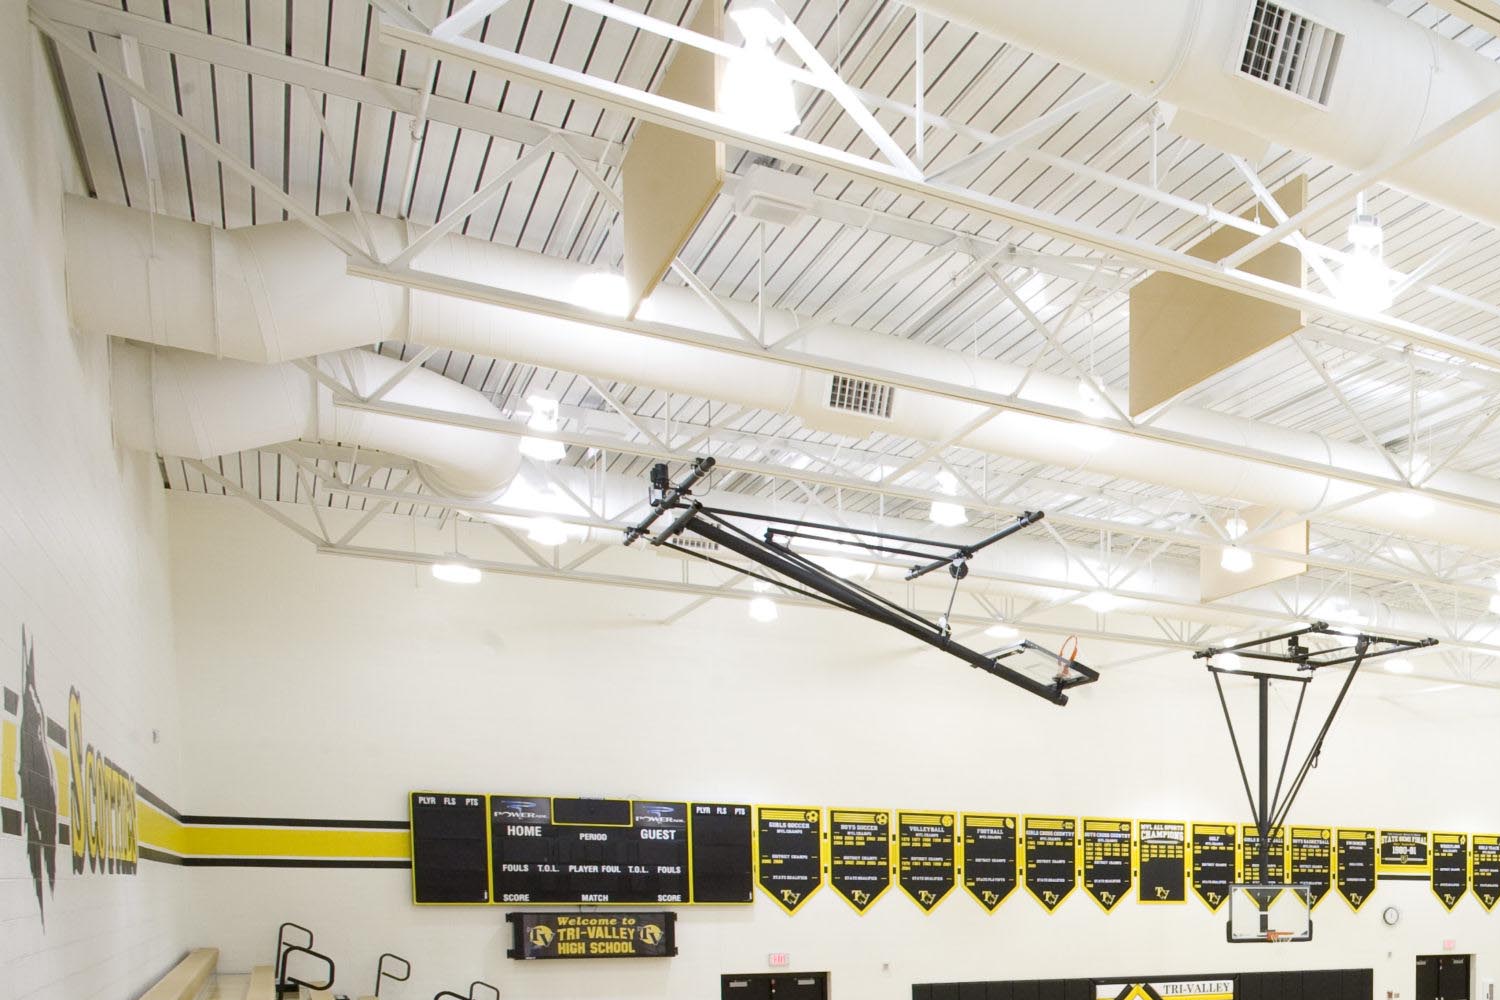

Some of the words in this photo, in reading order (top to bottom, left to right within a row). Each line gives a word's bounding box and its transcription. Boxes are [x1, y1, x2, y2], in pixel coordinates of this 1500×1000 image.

[418, 797, 436, 805] PLYR
[443, 797, 457, 805] FLS
[465, 798, 479, 806] PTS
[696, 806, 711, 814] PLYR
[716, 807, 728, 815] FLS
[507, 825, 542, 837] HOME
[640, 828, 676, 840] GUEST
[579, 832, 608, 841] PERIOD
[502, 864, 529, 872] FOULS
[537, 864, 560, 872] T.O.L.
[568, 865, 598, 873] PLAYER
[601, 865, 622, 873] FOUL
[627, 866, 649, 874] T.O.L.
[657, 866, 682, 874] FOULS
[503, 894, 530, 902] SCORE
[581, 894, 609, 902] MATCH
[657, 894, 682, 902] SCORE
[557, 916, 617, 926] Welcome
[623, 917, 636, 926] to
[557, 927, 636, 941] TRI-VALLEY
[557, 942, 586, 954] HIGH
[590, 941, 636, 954] SCHOOL
[1162, 982, 1231, 995] TRI-VALLEY
